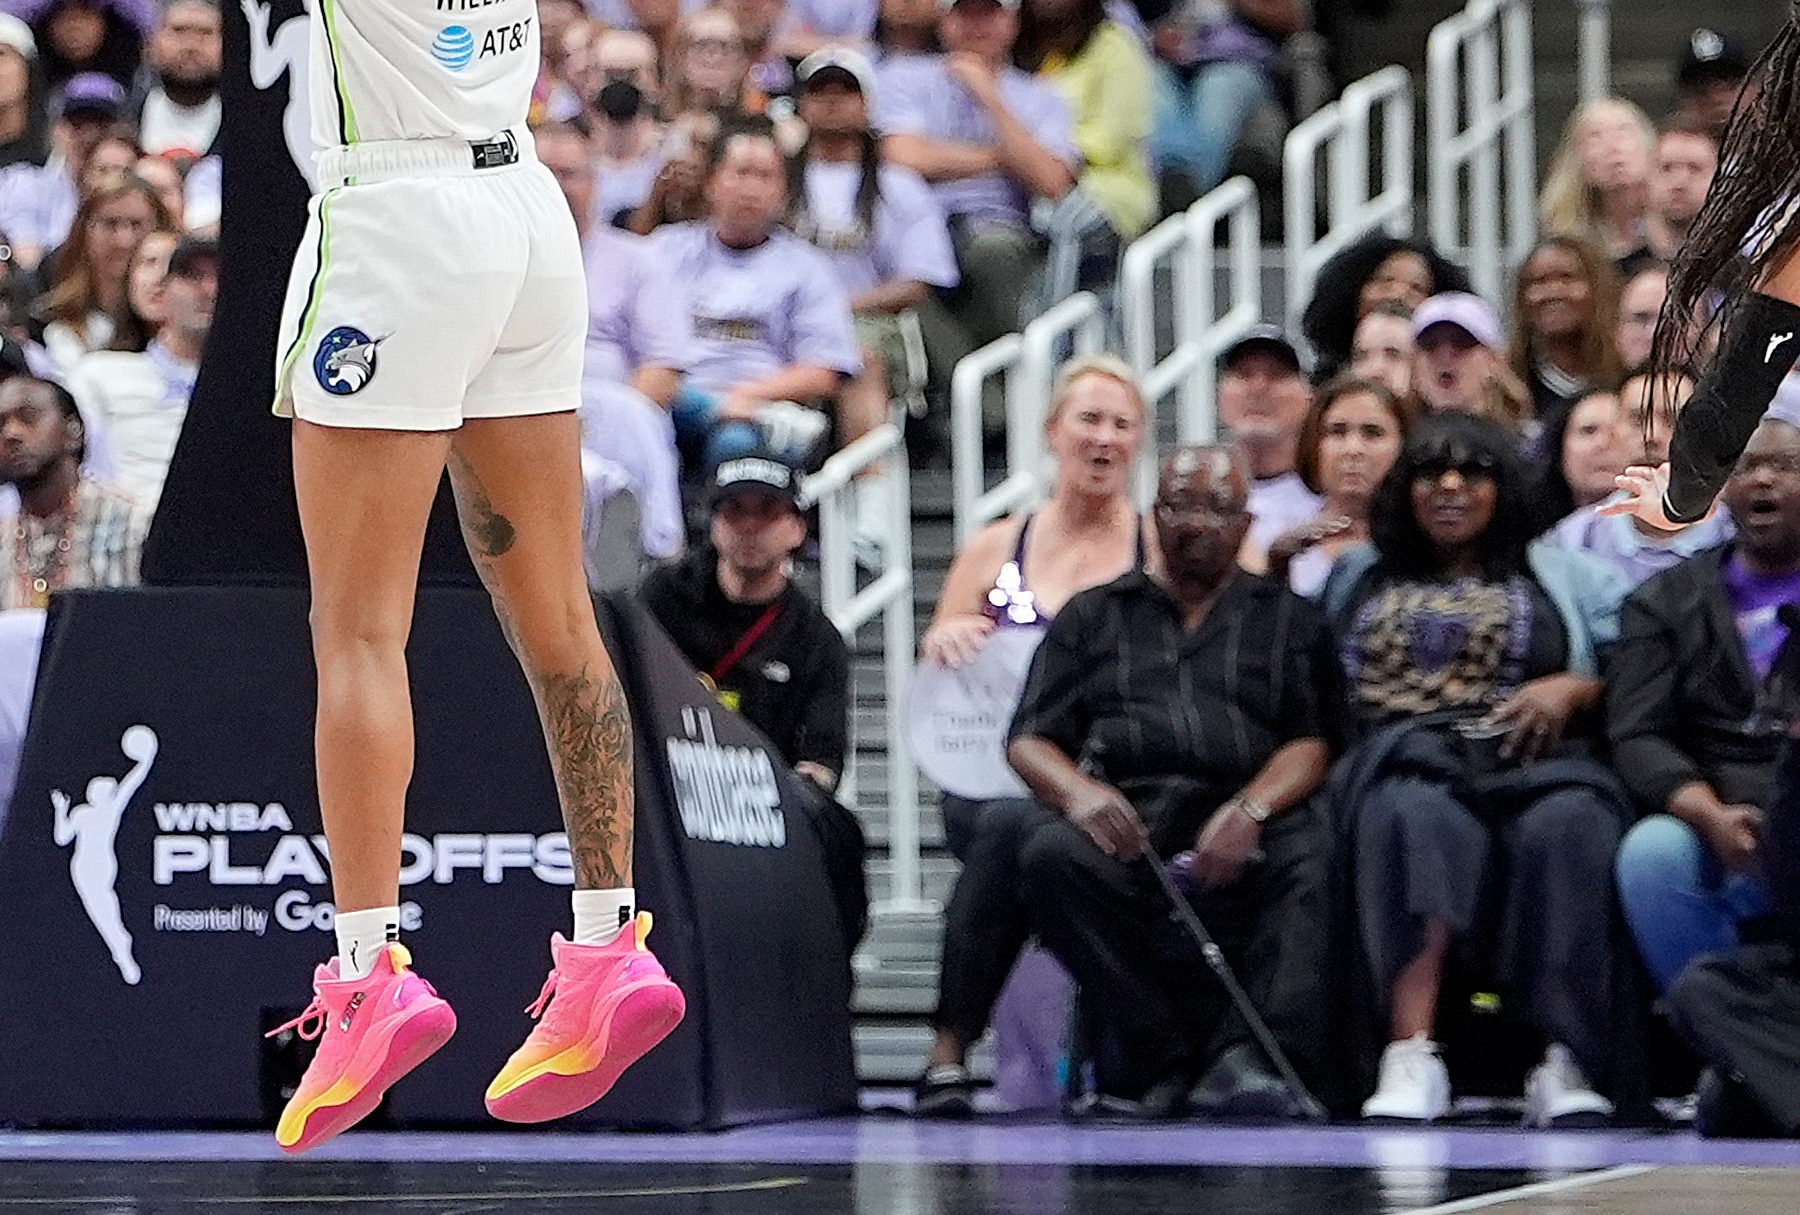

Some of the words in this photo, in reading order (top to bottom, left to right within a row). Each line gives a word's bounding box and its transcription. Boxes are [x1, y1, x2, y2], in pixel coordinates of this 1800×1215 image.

[479, 17, 532, 60] AT&T
[153, 802, 293, 832] WNBA
[153, 832, 577, 885] PLAOFFS
[274, 889, 424, 932] Goe
